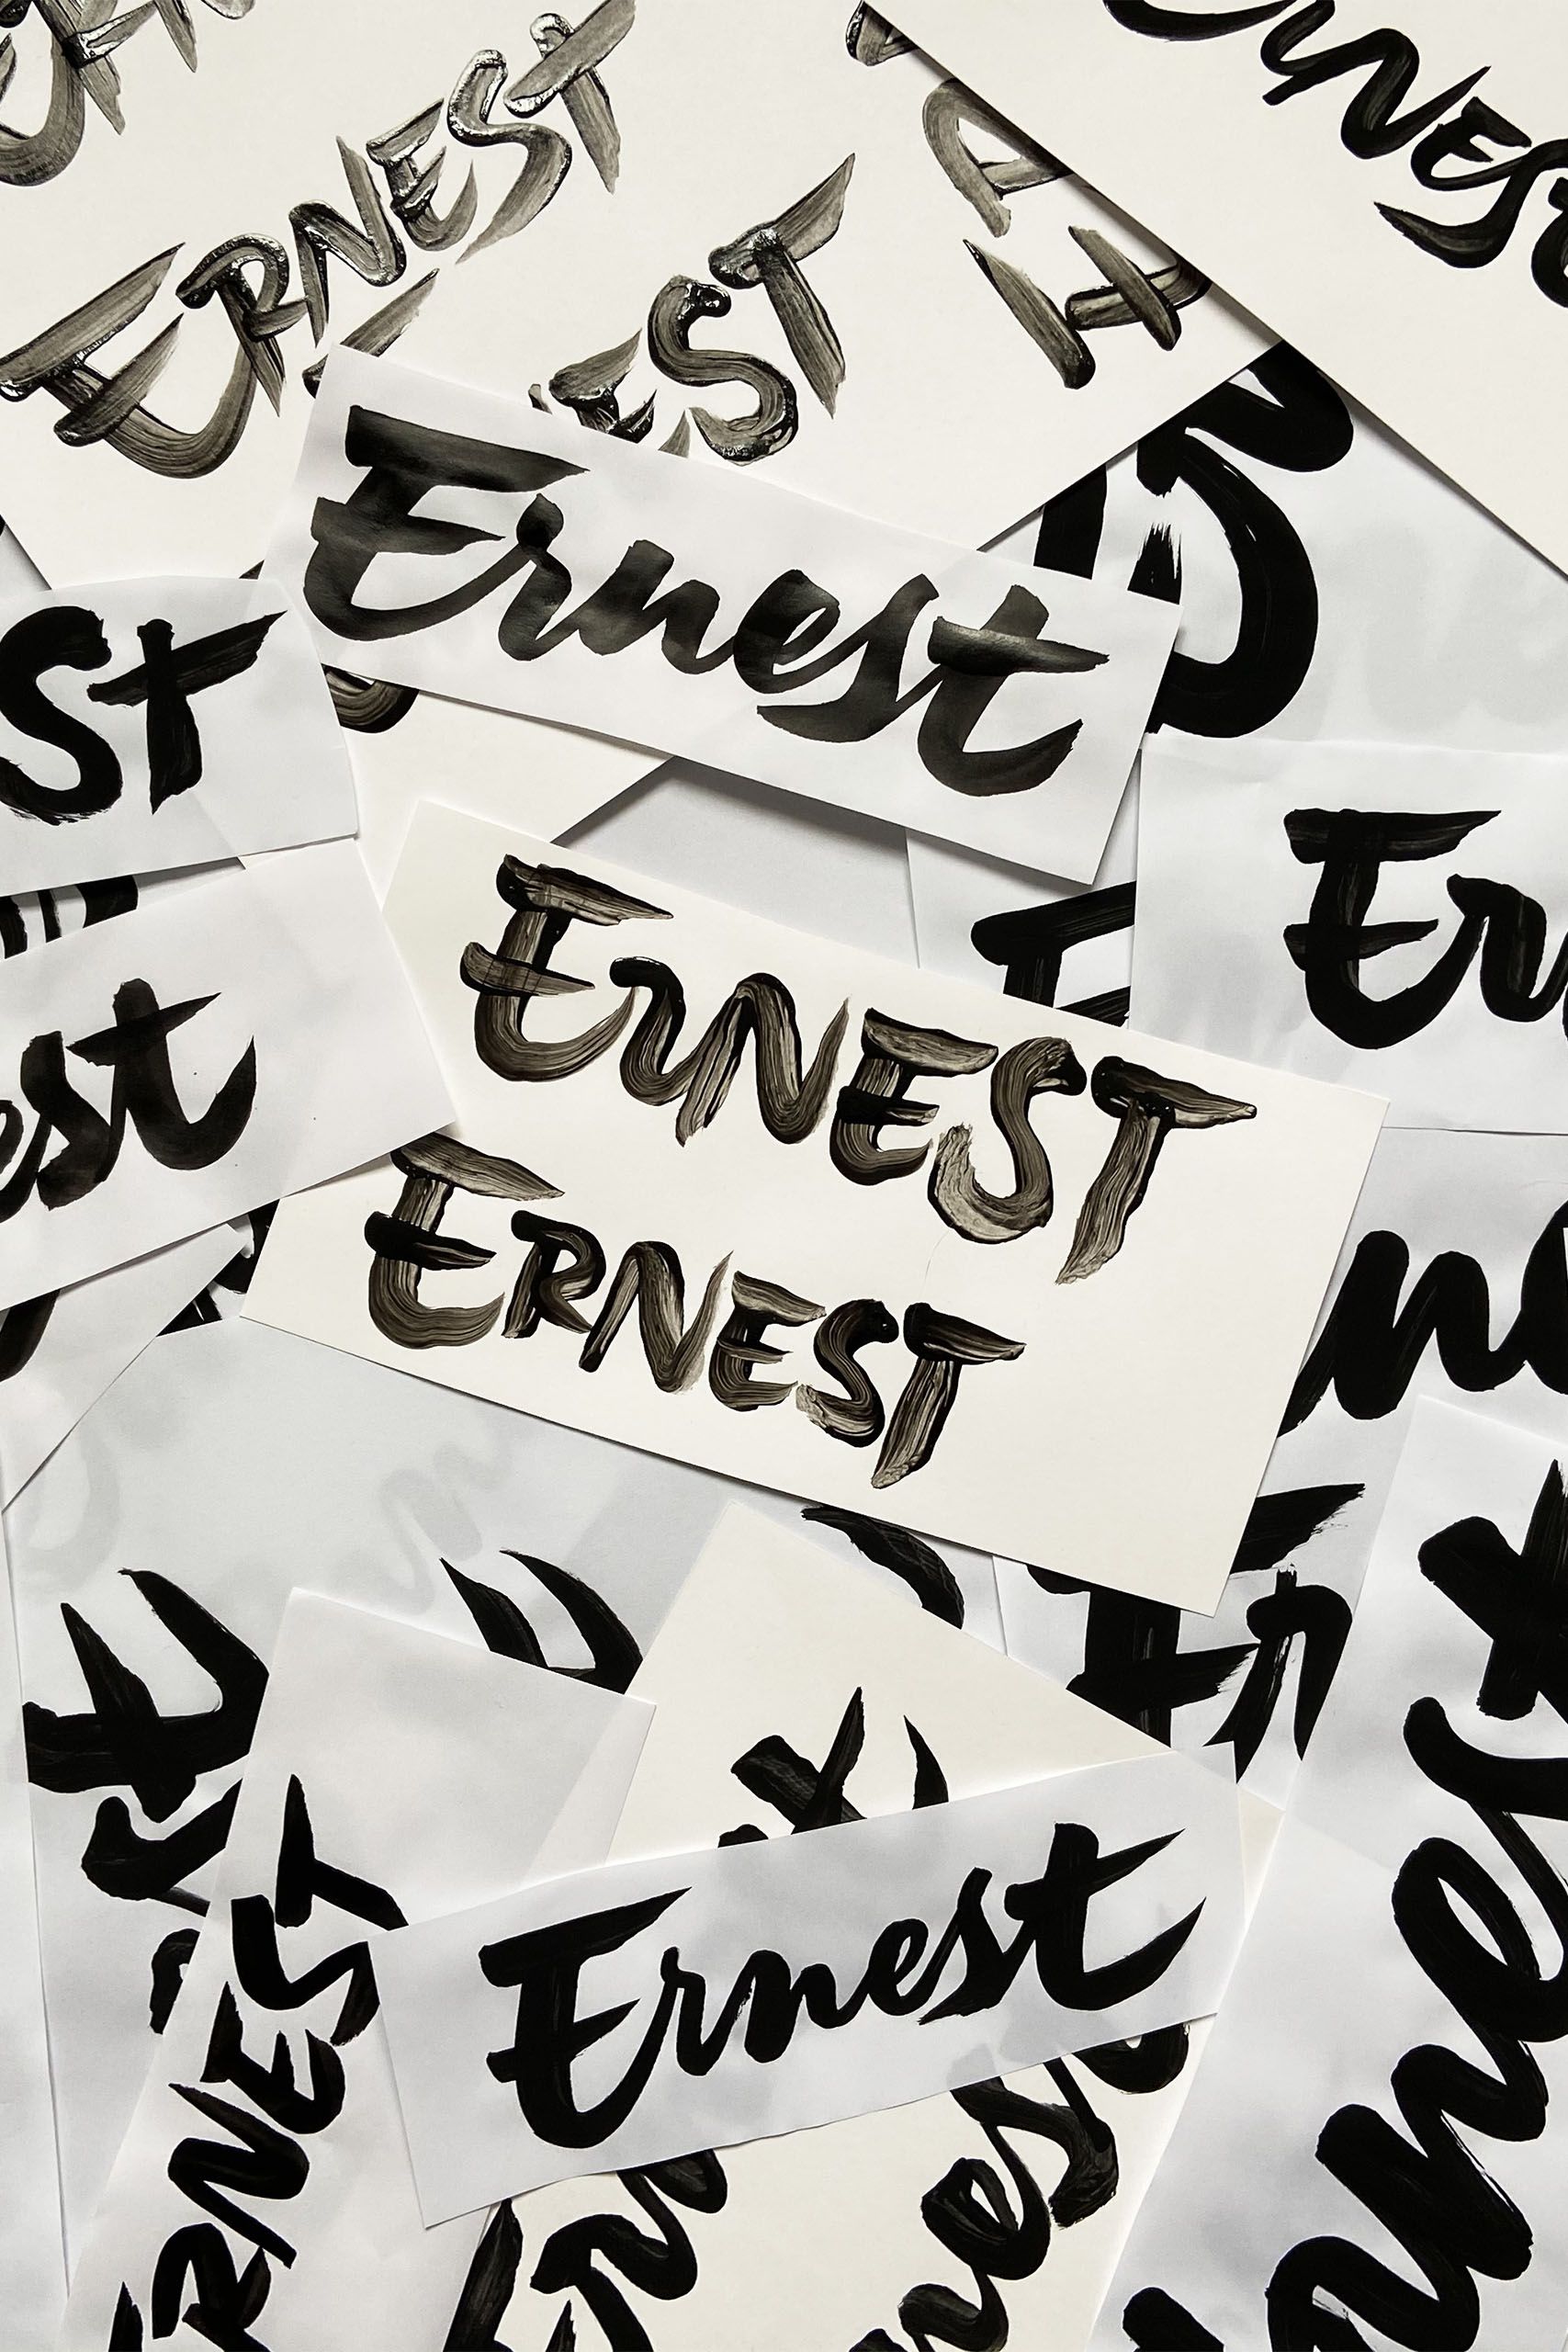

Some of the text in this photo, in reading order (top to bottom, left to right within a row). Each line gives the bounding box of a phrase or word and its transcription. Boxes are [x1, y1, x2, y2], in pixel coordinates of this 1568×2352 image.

[0, 0, 636, 480] ERNEST
[303, 404, 1110, 797] Ernest
[364, 1133, 1027, 1489] ERNEST
[479, 1823, 1206, 2149] Ernest
